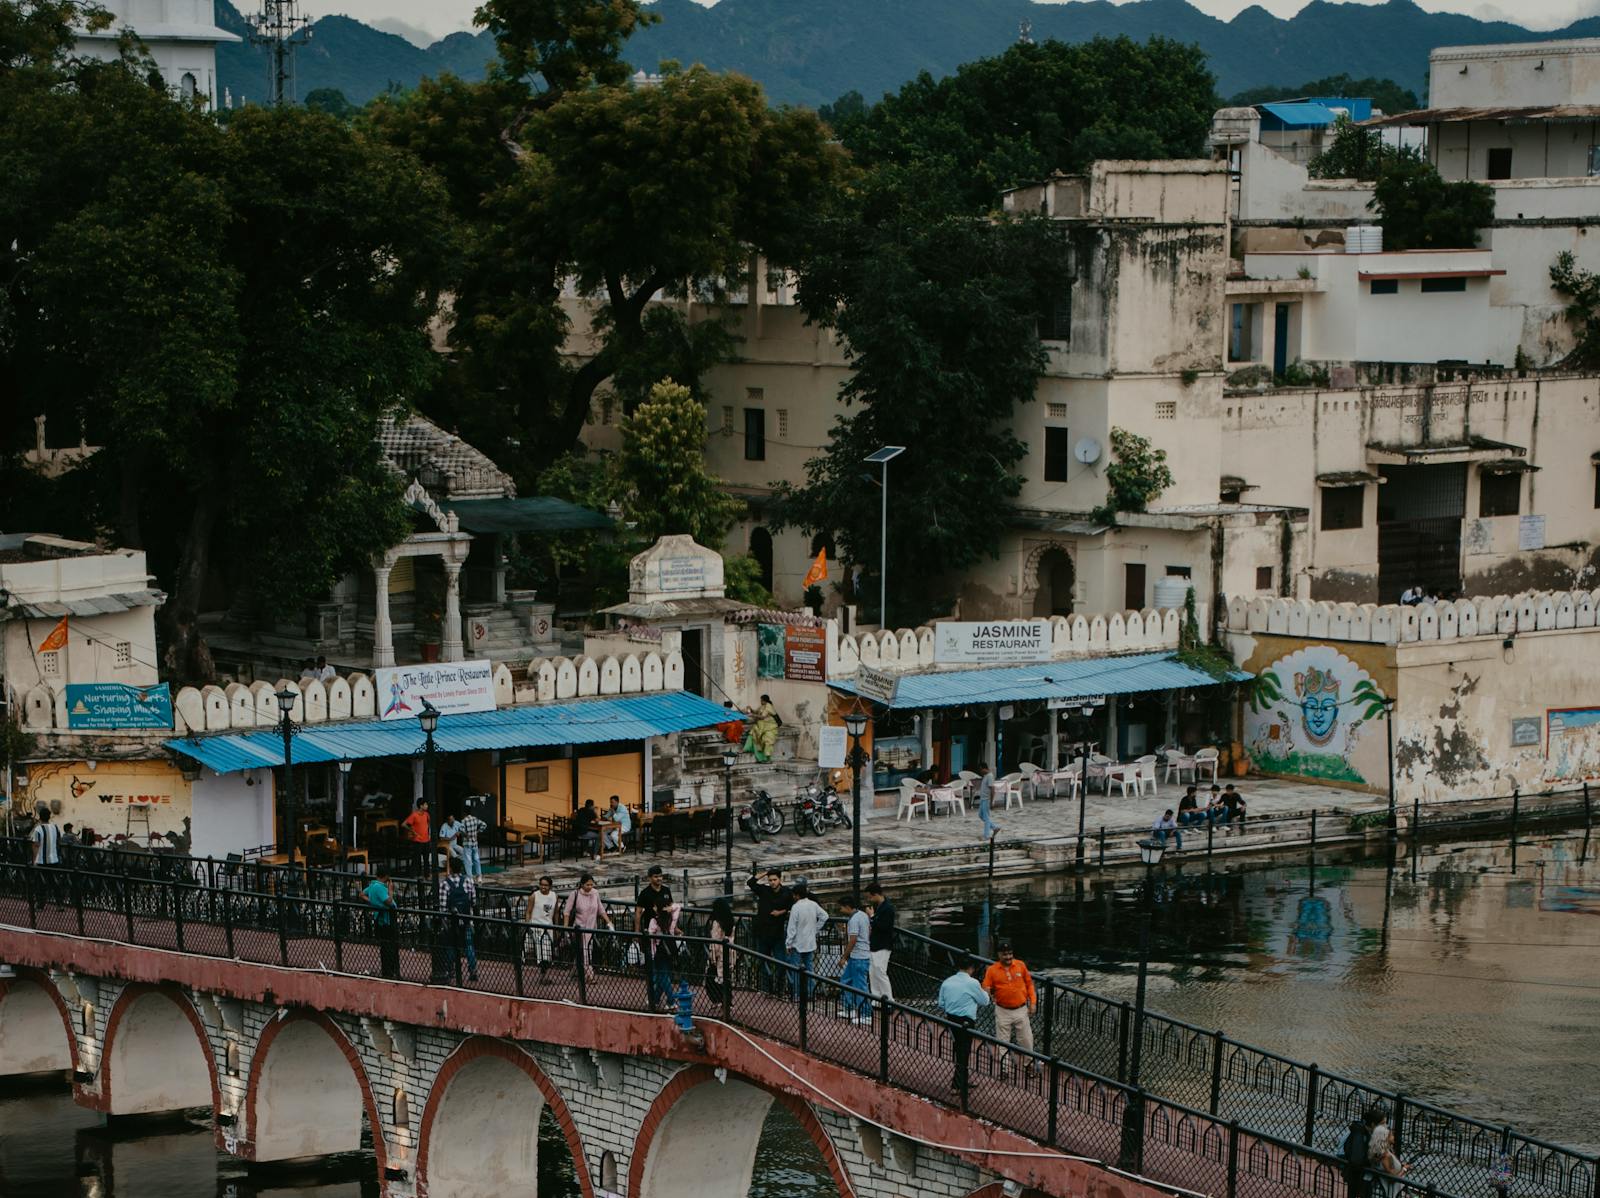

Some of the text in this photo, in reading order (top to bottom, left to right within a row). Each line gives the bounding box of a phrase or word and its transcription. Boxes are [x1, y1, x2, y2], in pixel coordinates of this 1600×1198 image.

[972, 625, 1041, 638] JASMINE
[972, 639, 1041, 649] RESTAURANT
[402, 668, 491, 689] The Little Prince Restaurant
[866, 672, 894, 687] JASMINE
[84, 692, 131, 705] Nurturing
[1060, 694, 1105, 702] JASMINE
[93, 704, 131, 717] Shaping
[98, 795, 123, 803] WE
